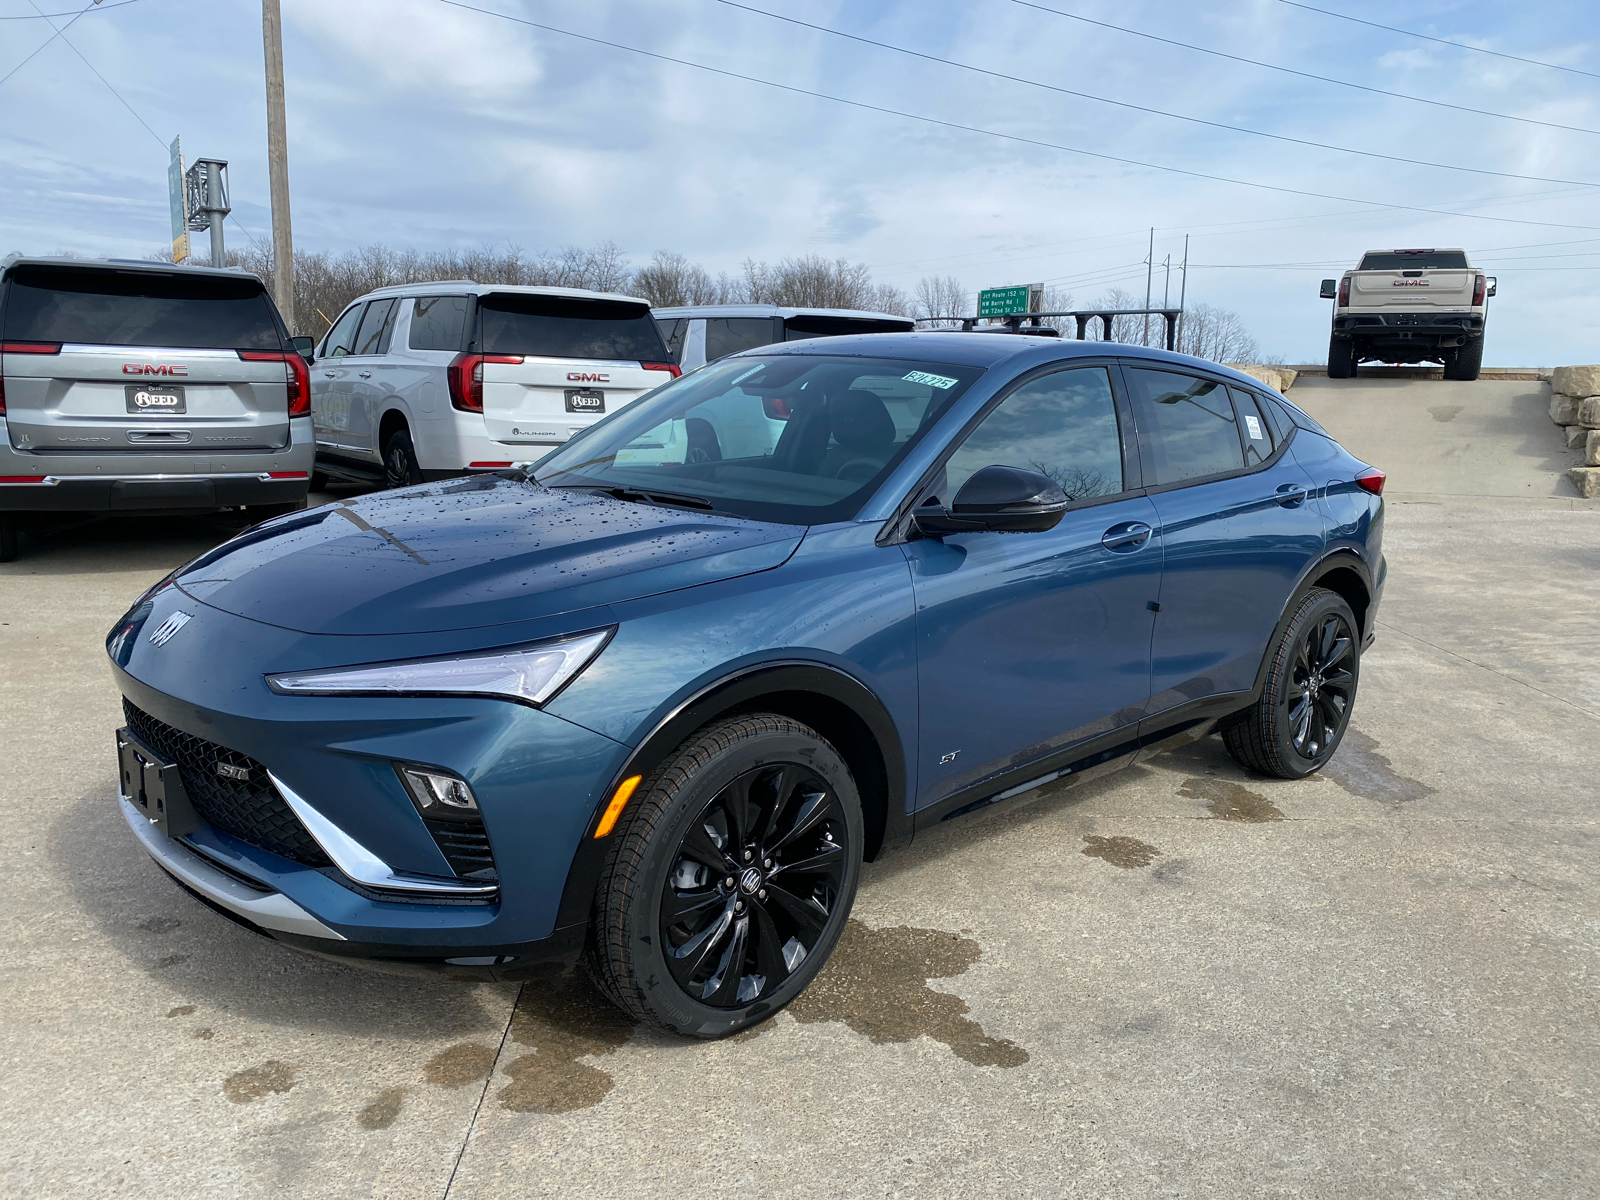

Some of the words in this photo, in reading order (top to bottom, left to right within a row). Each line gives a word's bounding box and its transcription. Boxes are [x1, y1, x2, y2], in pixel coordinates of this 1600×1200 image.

[122, 364, 188, 376] GMC
[567, 372, 610, 382] GMC
[134, 392, 178, 408] REED
[572, 395, 600, 408] REED
